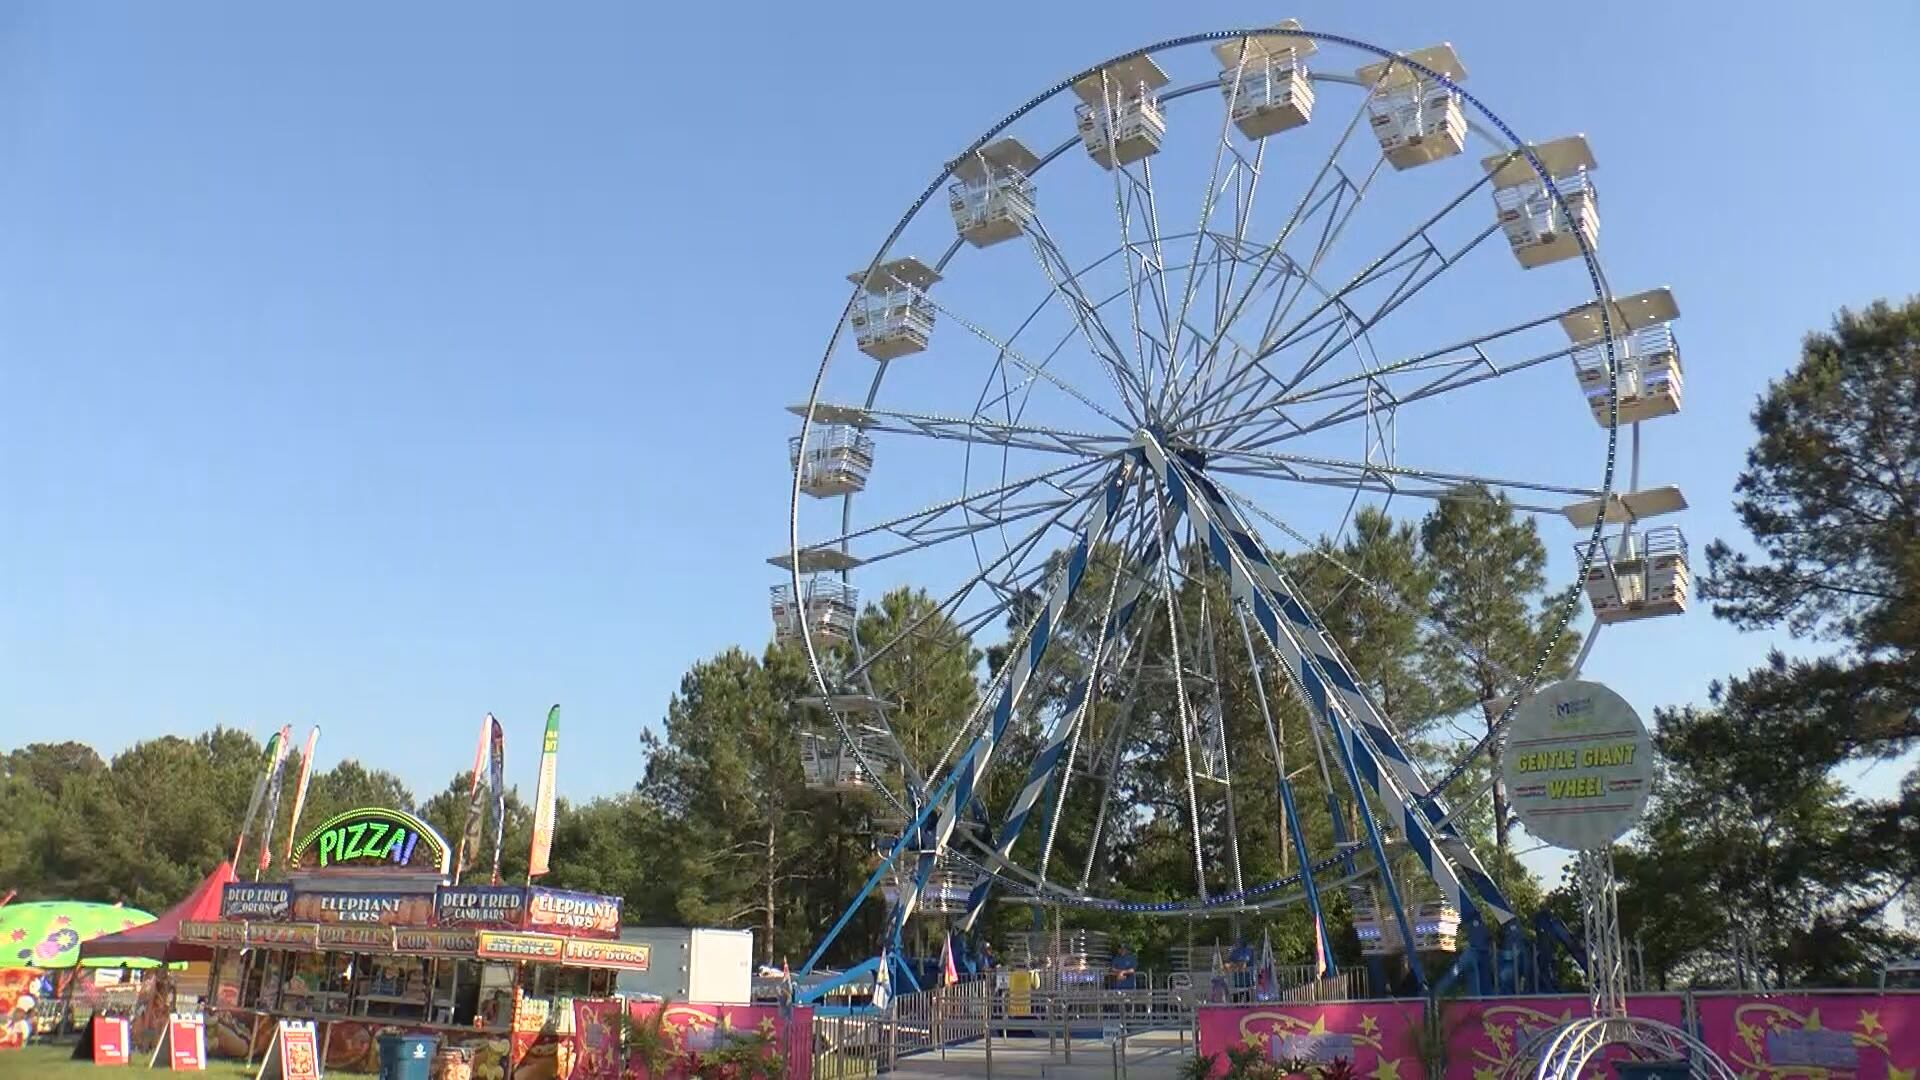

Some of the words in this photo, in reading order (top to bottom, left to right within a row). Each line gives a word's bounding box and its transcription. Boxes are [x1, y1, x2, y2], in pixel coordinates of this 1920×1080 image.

[1518, 751, 1576, 773] GENTLE
[1582, 745, 1636, 767] GIANT
[1548, 777, 1605, 799] WHEEL
[228, 888, 255, 901] DEEP
[256, 889, 288, 902] FRIED
[443, 893, 477, 907] DEEP
[480, 893, 520, 908] FRIED
[321, 897, 400, 912] ELEPHANT
[538, 895, 614, 918] ELEPHANT
[339, 911, 380, 922] EARS
[555, 914, 594, 929] EARS
